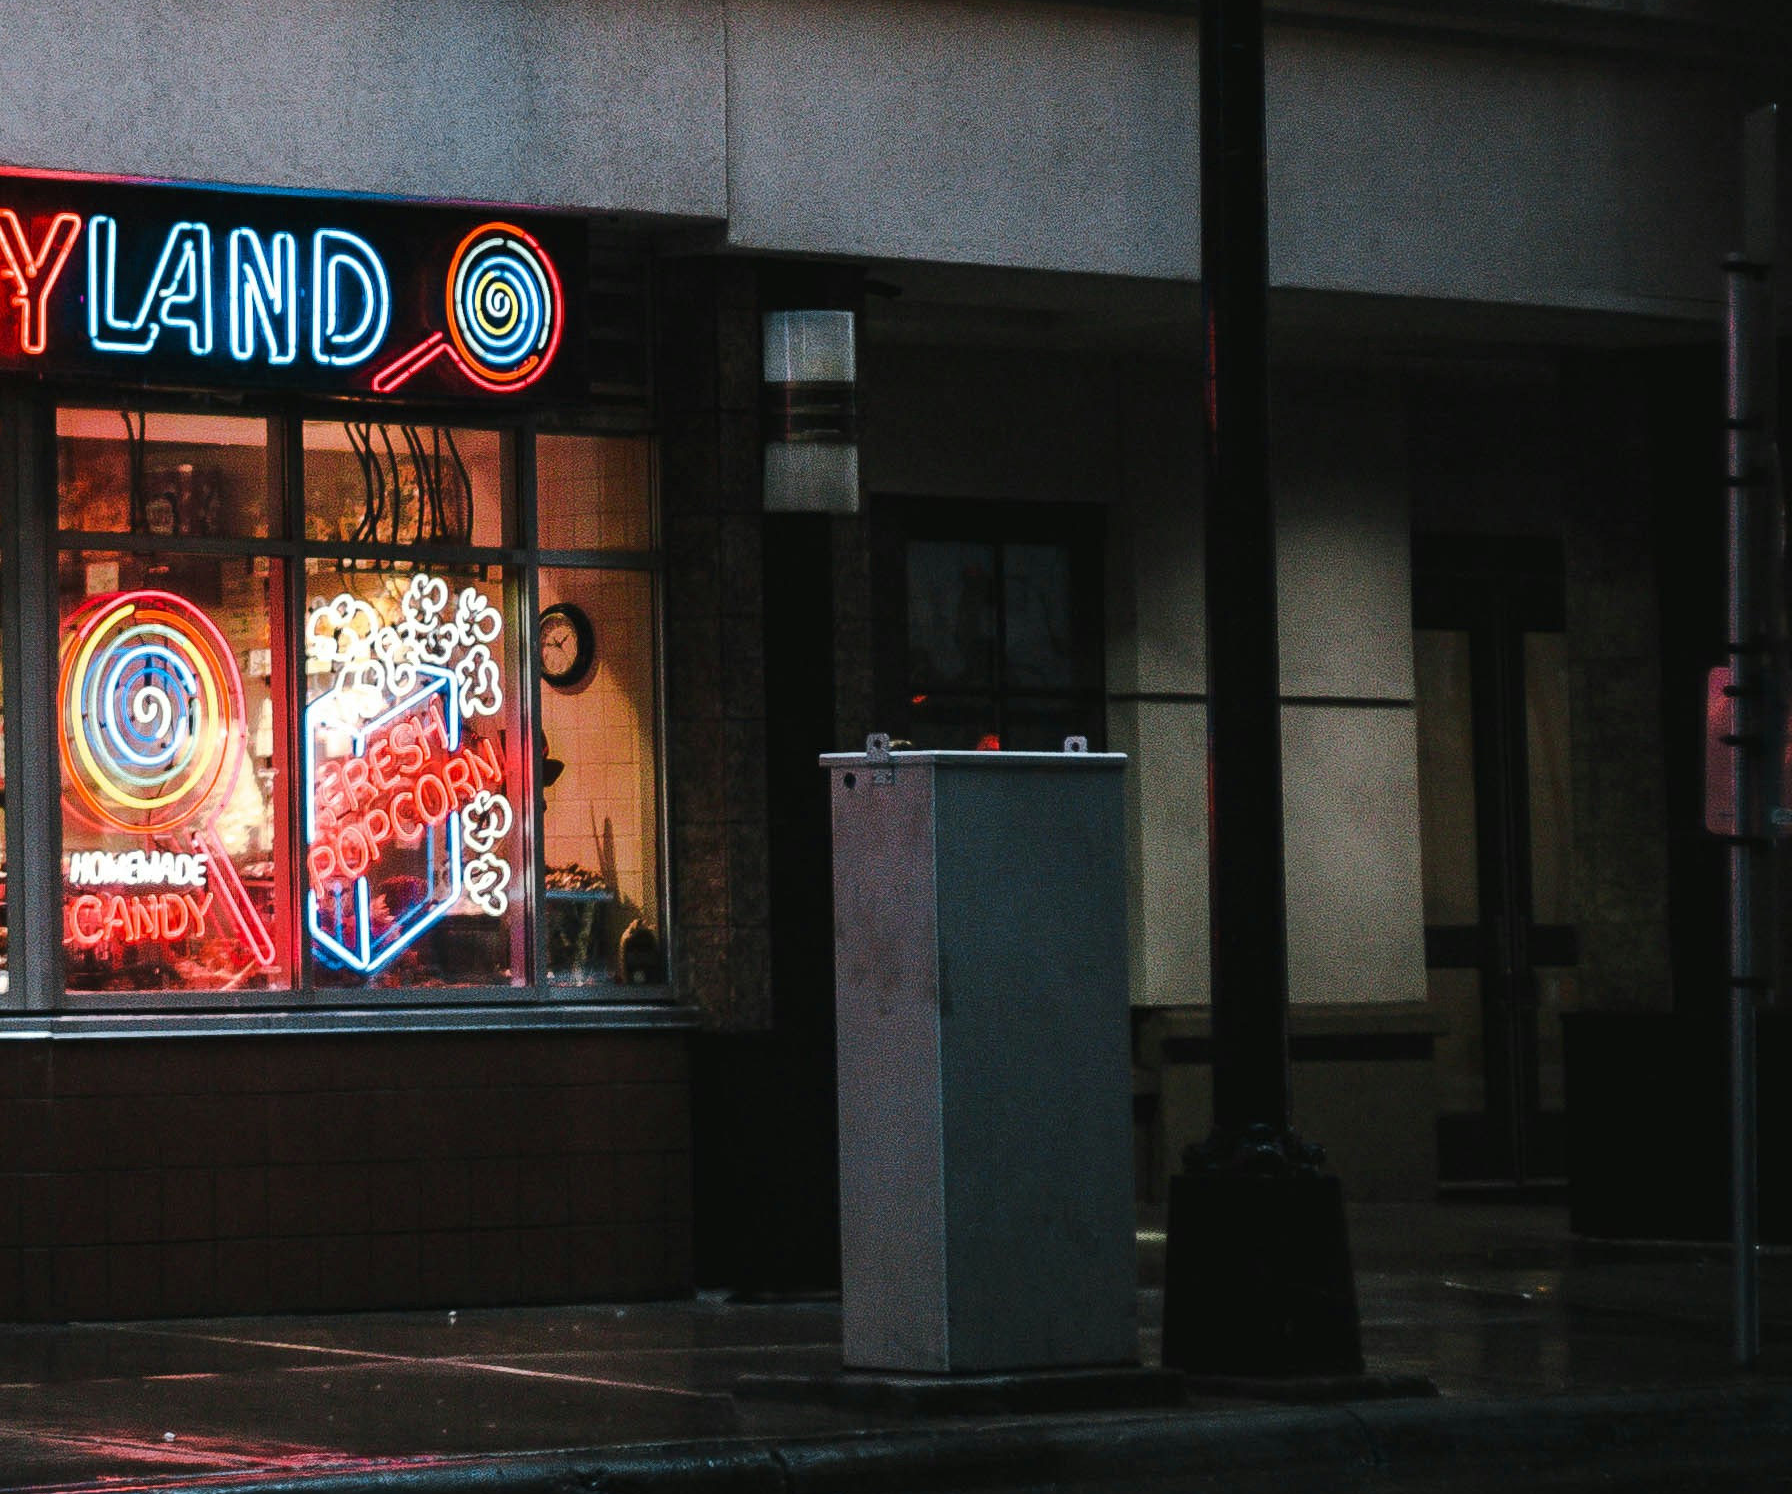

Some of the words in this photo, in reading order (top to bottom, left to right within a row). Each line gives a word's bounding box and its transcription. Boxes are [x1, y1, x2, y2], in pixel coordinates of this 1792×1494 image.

[317, 694, 450, 813] FRESH
[309, 738, 502, 898] POPCORN
[69, 850, 209, 886] HOMEMADE
[69, 892, 214, 945] CANDY
